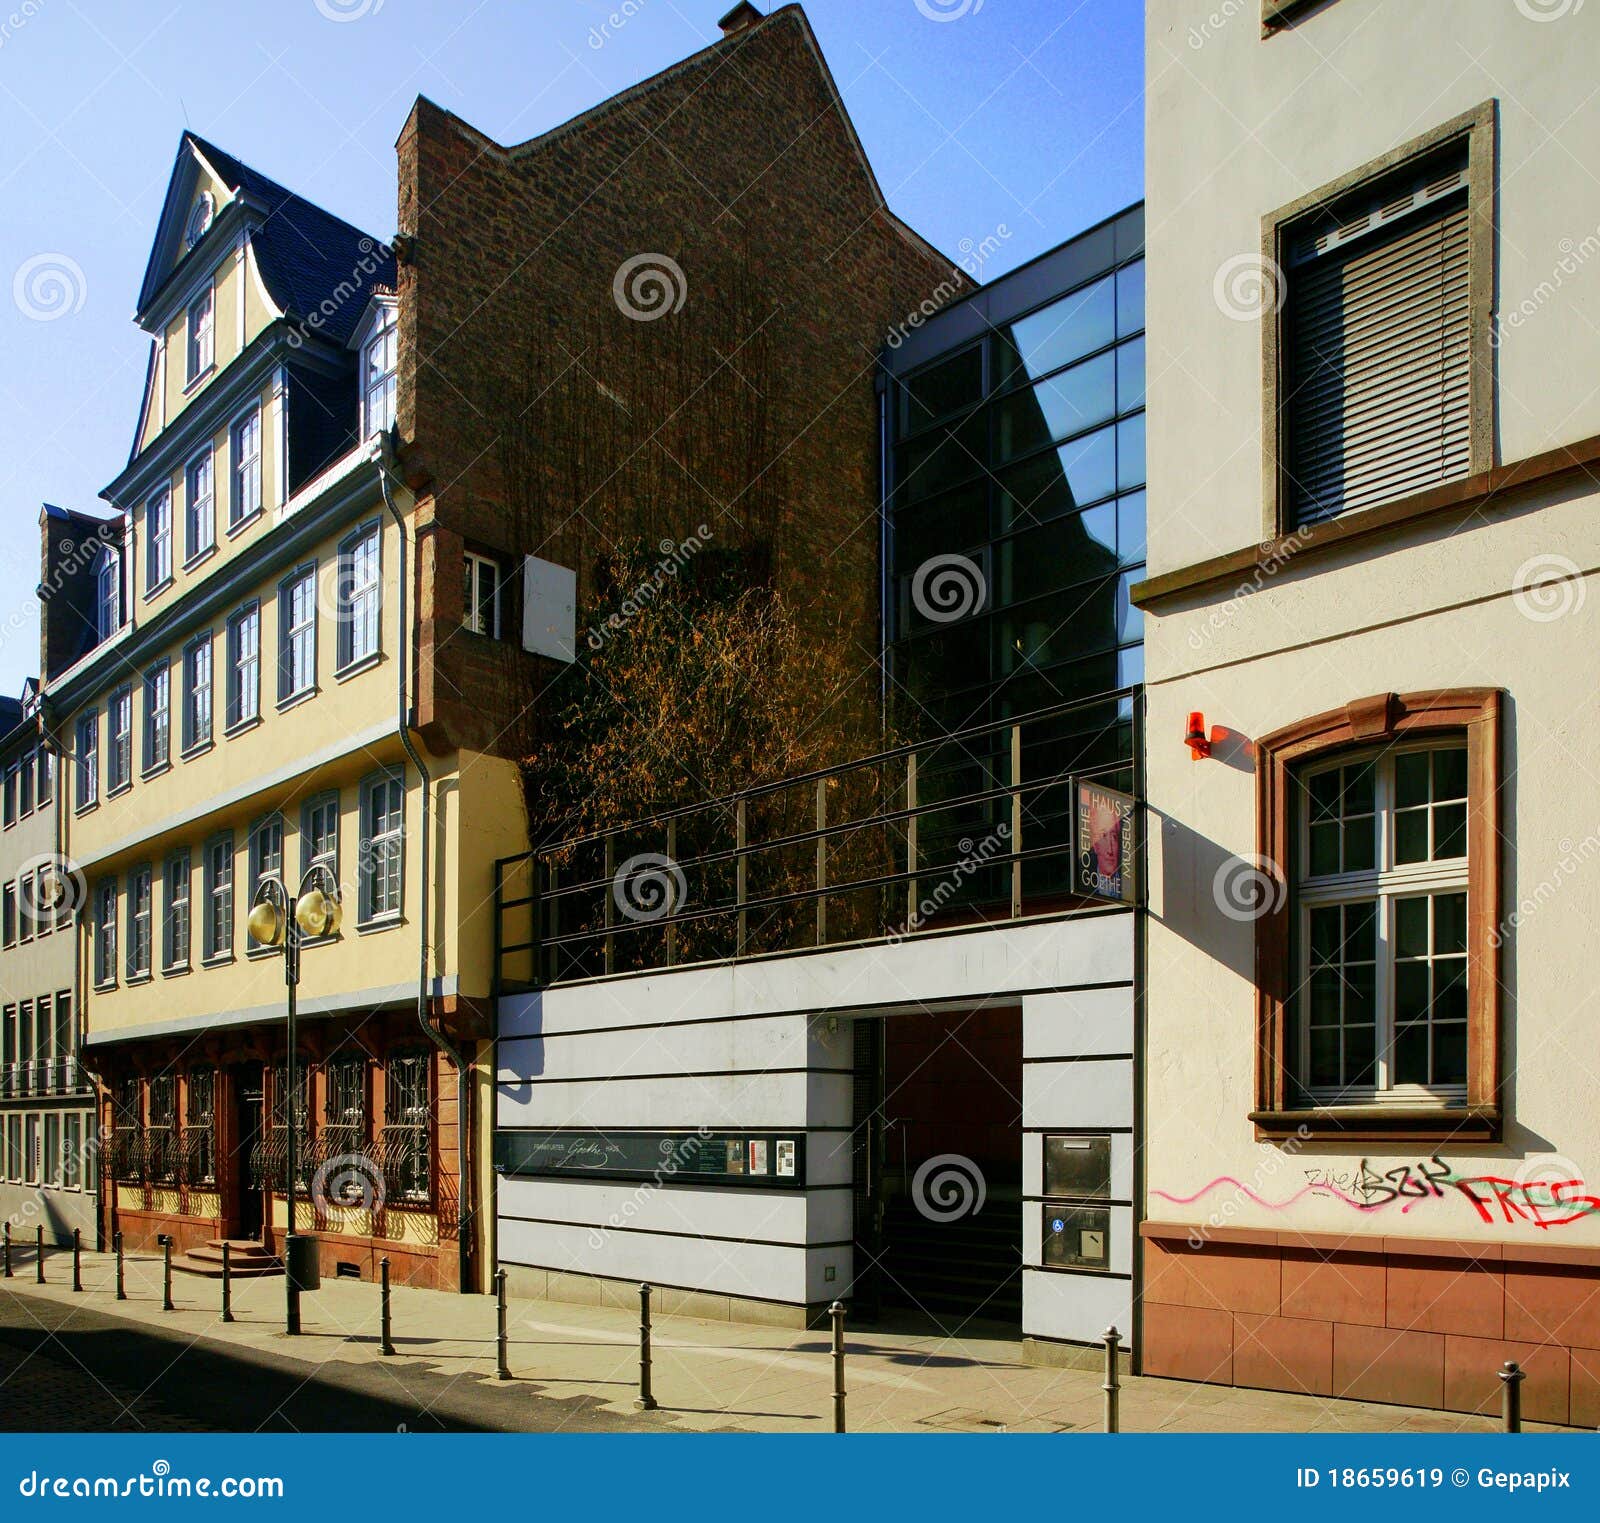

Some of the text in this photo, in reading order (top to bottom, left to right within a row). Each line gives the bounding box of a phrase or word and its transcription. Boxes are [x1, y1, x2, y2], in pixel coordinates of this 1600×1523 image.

[1092, 791, 1121, 817] HAUS
[1121, 805, 1134, 878] MUSEUM
[1081, 869, 1121, 894] GOETHE
